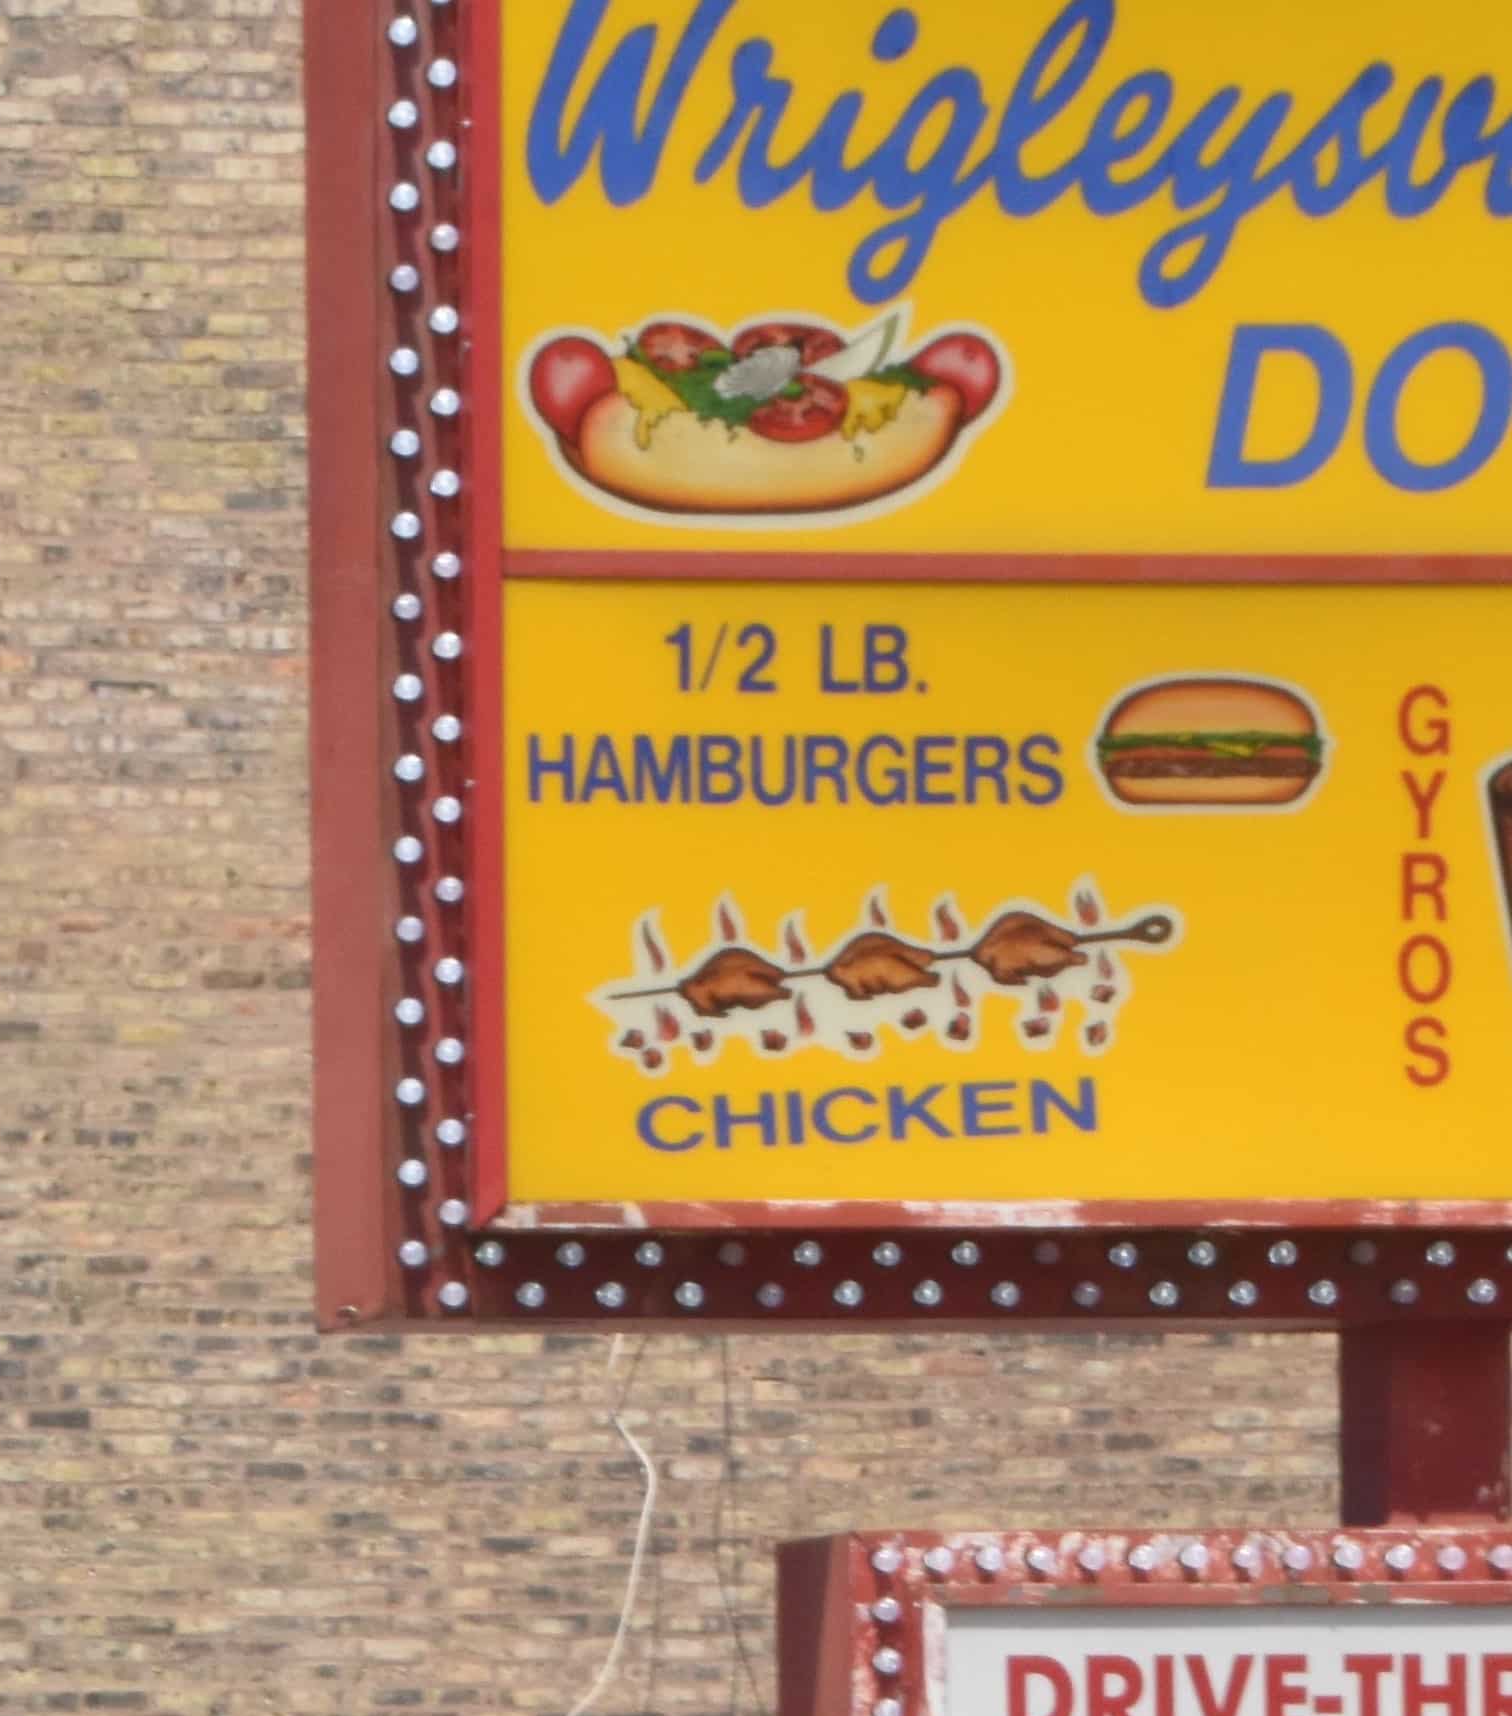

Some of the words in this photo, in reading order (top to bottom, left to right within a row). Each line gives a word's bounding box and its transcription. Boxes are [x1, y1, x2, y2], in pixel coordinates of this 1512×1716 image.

[1206, 321, 1512, 493] DO
[663, 624, 778, 692] 1/2
[819, 624, 928, 693] LB.
[527, 735, 1064, 807] HAMBURGERS
[1398, 684, 1452, 1088] GYROS
[635, 1077, 1099, 1152] CHICKEN
